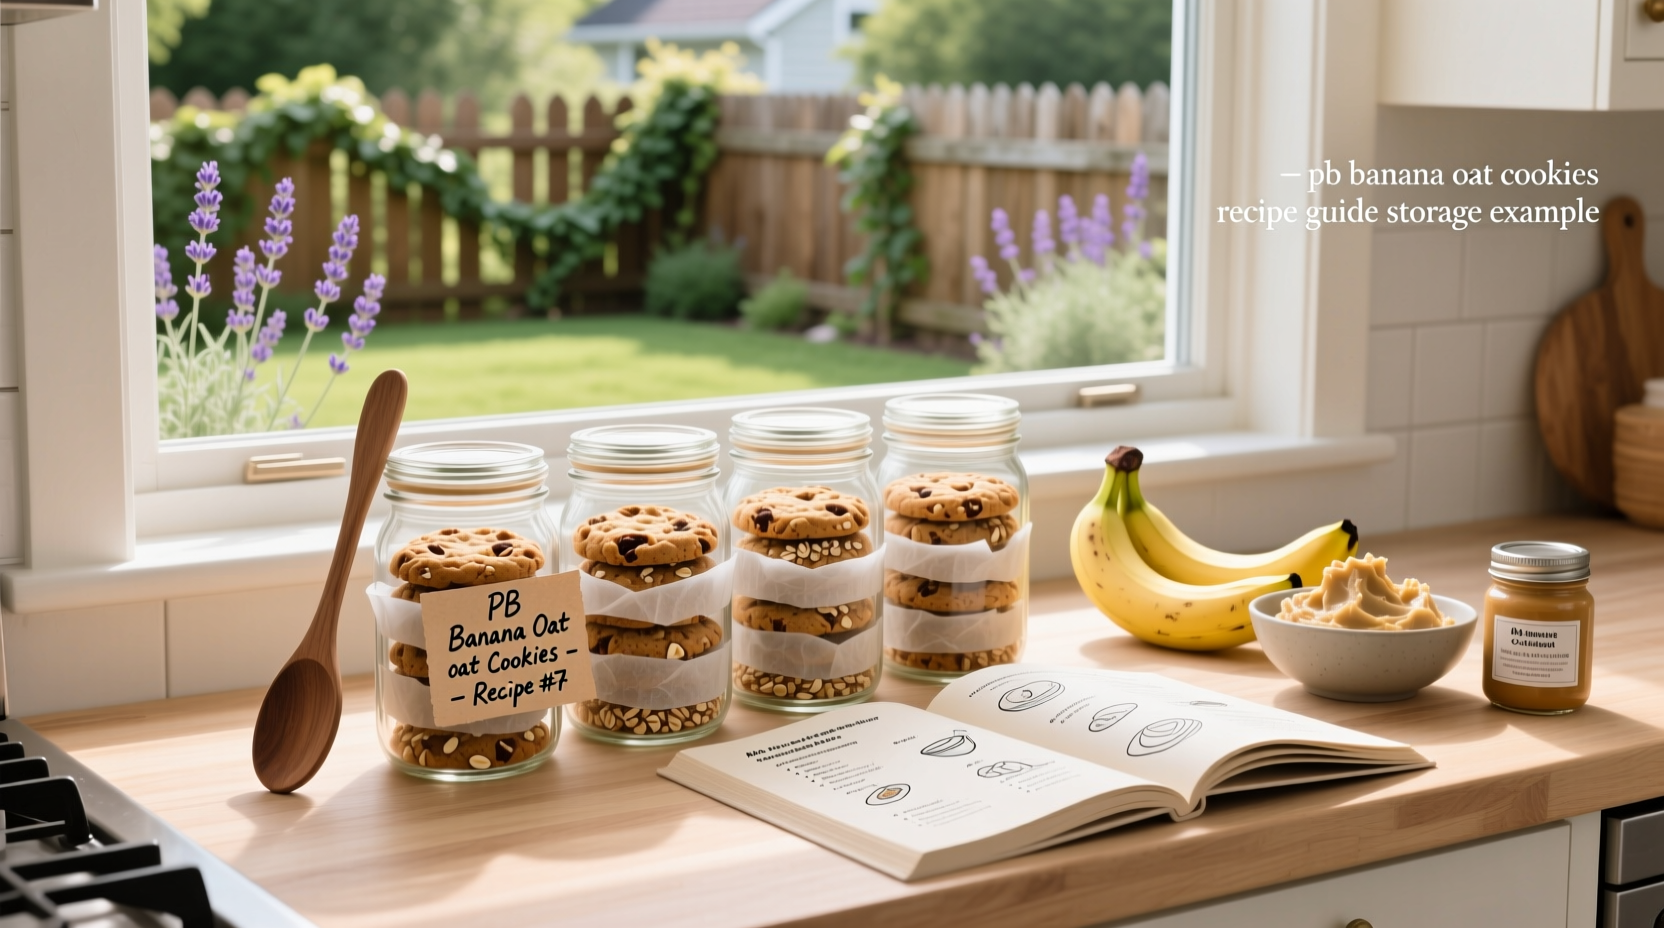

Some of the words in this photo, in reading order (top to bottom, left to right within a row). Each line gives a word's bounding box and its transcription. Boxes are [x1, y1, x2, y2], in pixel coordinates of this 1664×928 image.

[488, 589, 521, 621] PB
[448, 624, 526, 652] Banana
[532, 611, 570, 637] Oat
[448, 655, 480, 678] oat
[487, 646, 558, 673] Cookies
[473, 680, 534, 708] Recipe
[538, 669, 568, 693] #7
